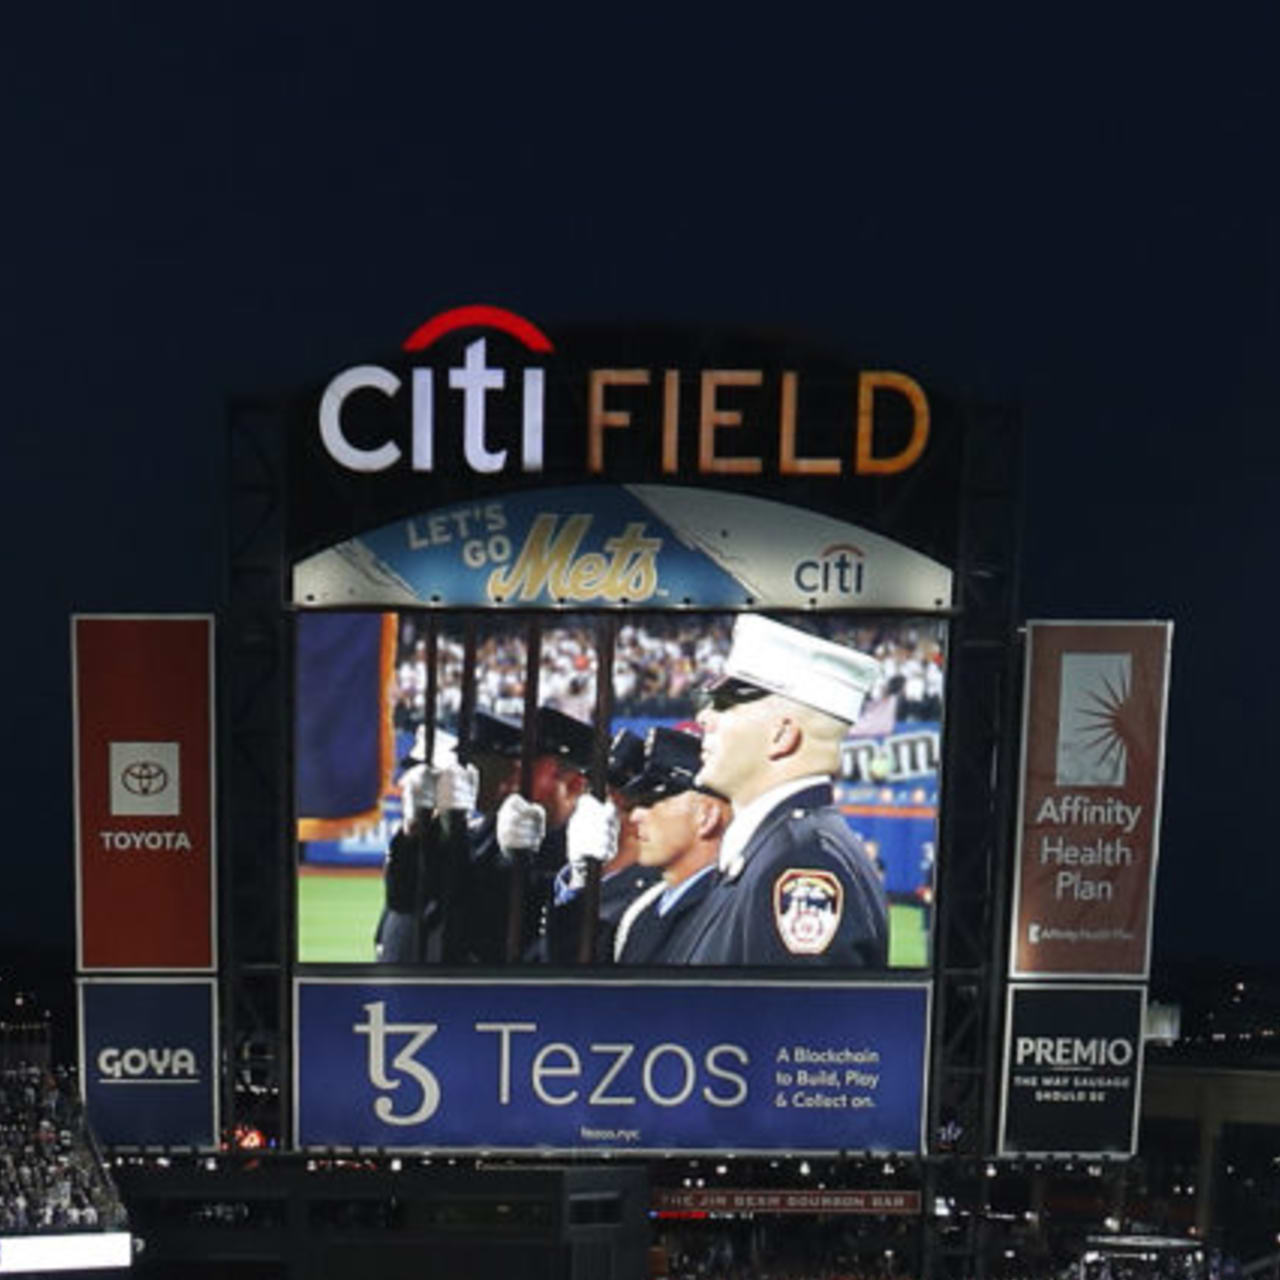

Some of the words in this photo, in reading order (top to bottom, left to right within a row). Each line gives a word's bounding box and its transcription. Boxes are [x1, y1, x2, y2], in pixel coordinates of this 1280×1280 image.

[318, 337, 545, 474] citi
[588, 369, 931, 476] FIELD
[406, 504, 508, 550] LET'S
[462, 535, 511, 569] GO
[487, 512, 664, 603] Mets
[794, 552, 864, 595] citi
[1037, 796, 1143, 833] Affinity
[99, 831, 192, 851] TOYOTA
[1040, 836, 1132, 866] Health
[1055, 871, 1112, 900] Plan
[97, 1048, 197, 1078] GOYA
[475, 1022, 751, 1107] Tezos
[776, 1047, 790, 1063] A
[794, 1046, 880, 1063] Blockchain
[1016, 1036, 1134, 1066] PREMIO
[776, 1070, 793, 1086] to
[797, 1069, 841, 1090] Build,
[845, 1069, 880, 1090] Play
[791, 1091, 848, 1108] Collect
